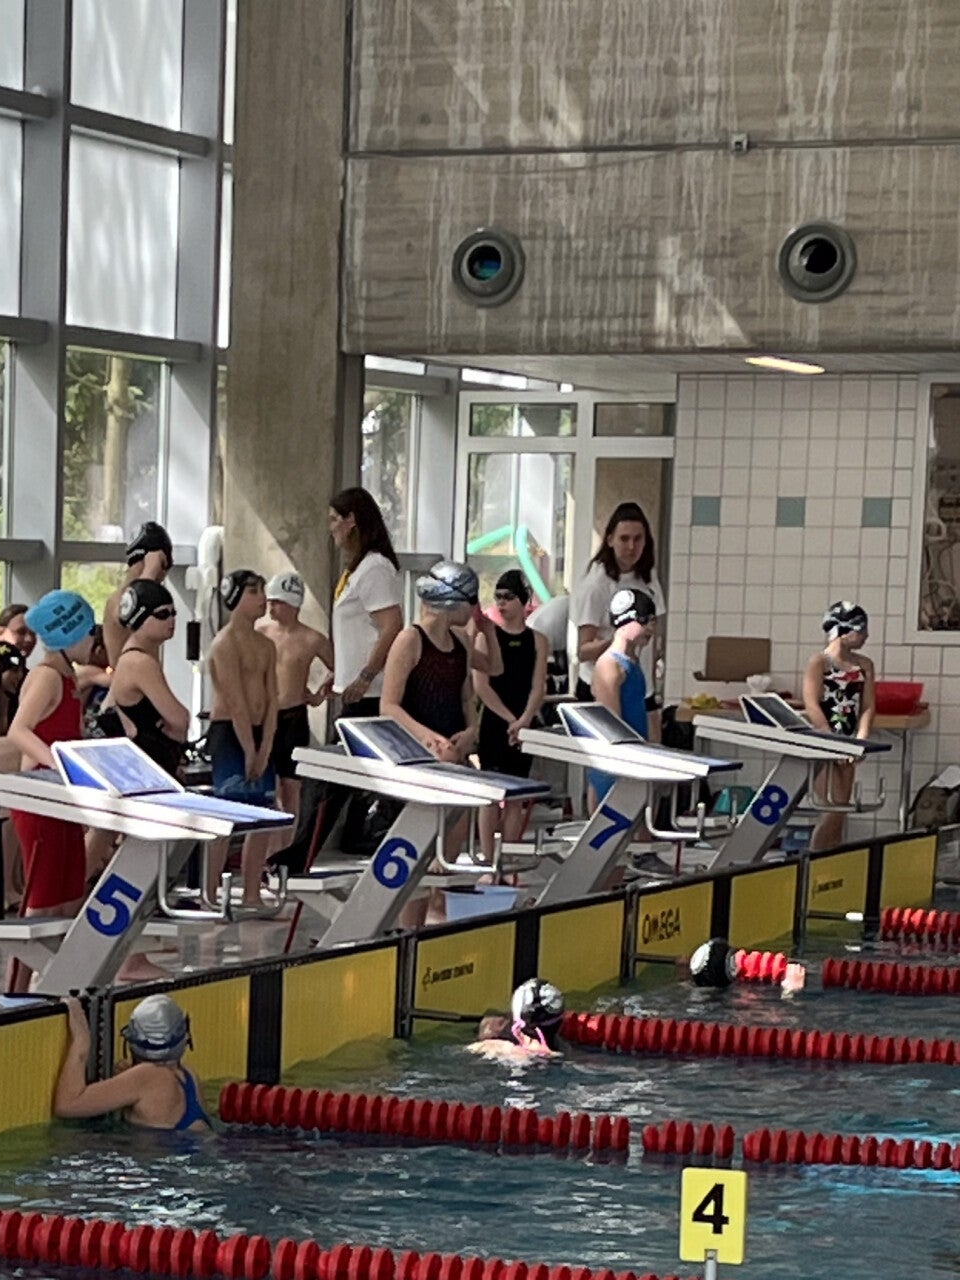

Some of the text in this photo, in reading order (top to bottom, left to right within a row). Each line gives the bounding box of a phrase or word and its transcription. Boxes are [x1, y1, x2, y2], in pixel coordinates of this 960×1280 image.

[589, 804, 633, 850] 7
[751, 785, 789, 826] 8
[373, 837, 418, 889] 6
[86, 873, 143, 937] 5
[692, 1183, 729, 1235] 4
